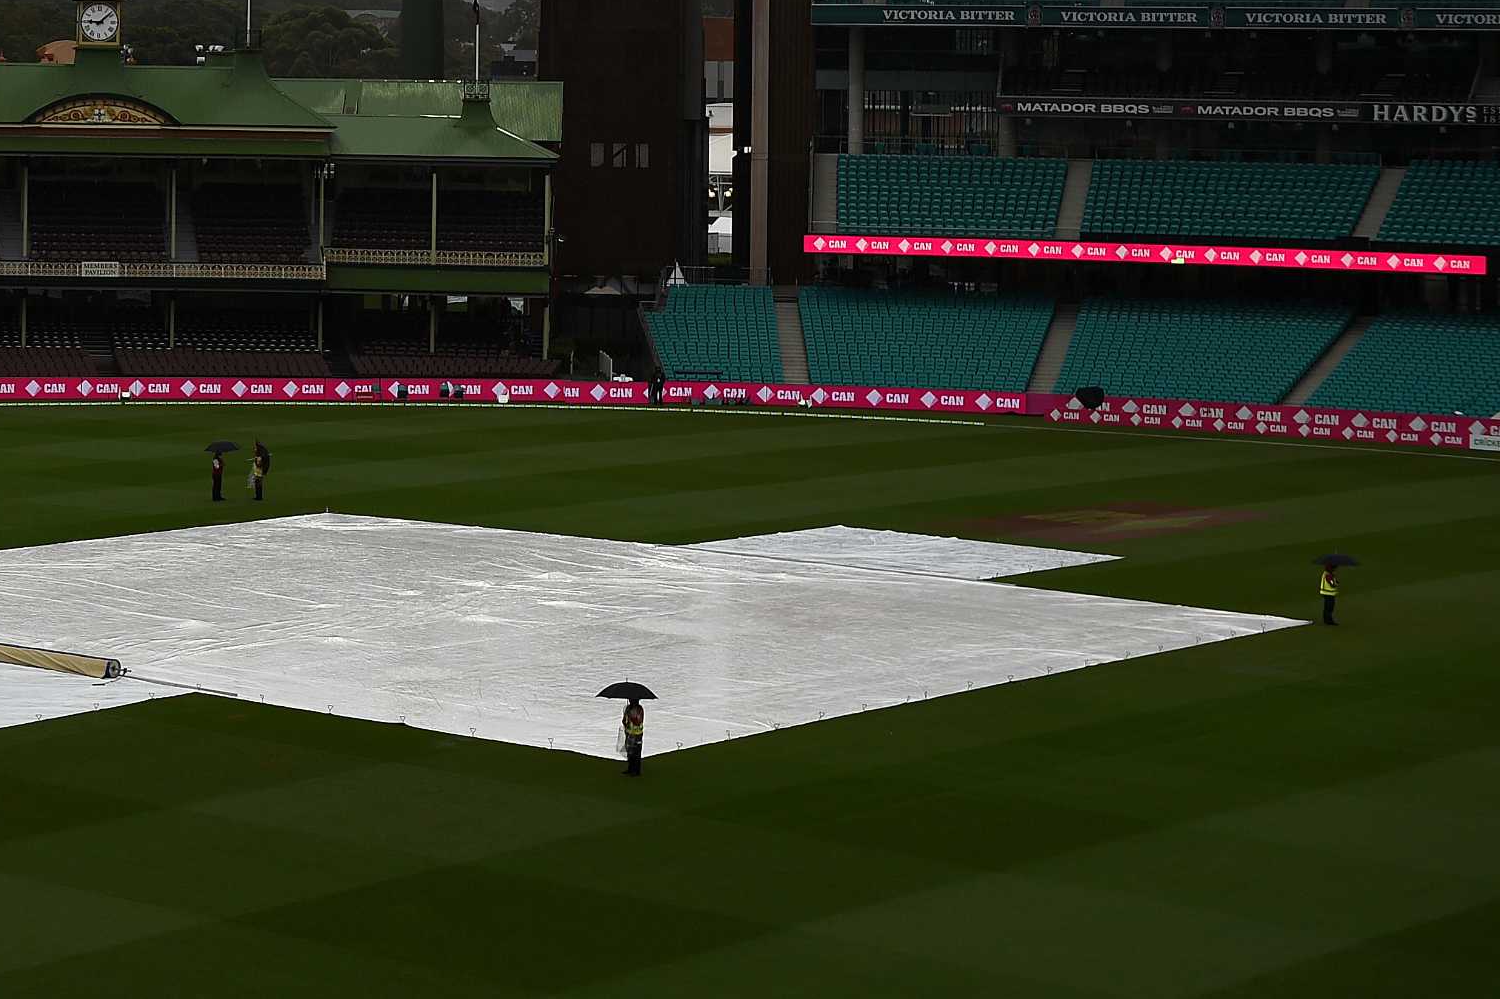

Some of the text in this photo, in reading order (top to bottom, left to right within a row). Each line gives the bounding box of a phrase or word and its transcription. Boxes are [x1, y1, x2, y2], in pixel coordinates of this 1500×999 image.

[883, 9, 1015, 21] VICTORIA BITTER
[1060, 10, 1198, 23] VICTORIA BITTER
[1245, 12, 1387, 24] VICTORIA BITTER
[1017, 102, 1097, 113] MATADOR
[1100, 104, 1150, 114] BBQS
[1197, 105, 1279, 116] MATADOR
[1283, 107, 1335, 118] BBQS
[1373, 104, 1477, 123] HARDYS
[1451, 260, 1470, 268] CAN
[45, 383, 66, 393] CAN
[96, 384, 118, 394] CAN
[149, 384, 170, 393] CAN
[201, 384, 221, 393] CAN
[251, 384, 273, 393] CAN
[302, 385, 324, 394] CAN
[409, 385, 430, 394] CAN
[511, 386, 533, 395] CAN
[611, 388, 633, 397] CAN
[777, 390, 800, 400] CAN
[833, 392, 855, 401] CAN
[887, 394, 909, 403] CAN
[942, 396, 964, 405] CAN
[998, 398, 1020, 408] CAN
[1142, 404, 1167, 415] CAN
[1200, 408, 1224, 418] CAN
[1258, 411, 1282, 422] CAN
[1315, 414, 1340, 425] CAN
[1373, 418, 1397, 429] CAN
[1431, 422, 1456, 432] CAN
[1063, 412, 1463, 445] CAN CAN CAN CAN CAN CAN CAN CAN CAN CAN
